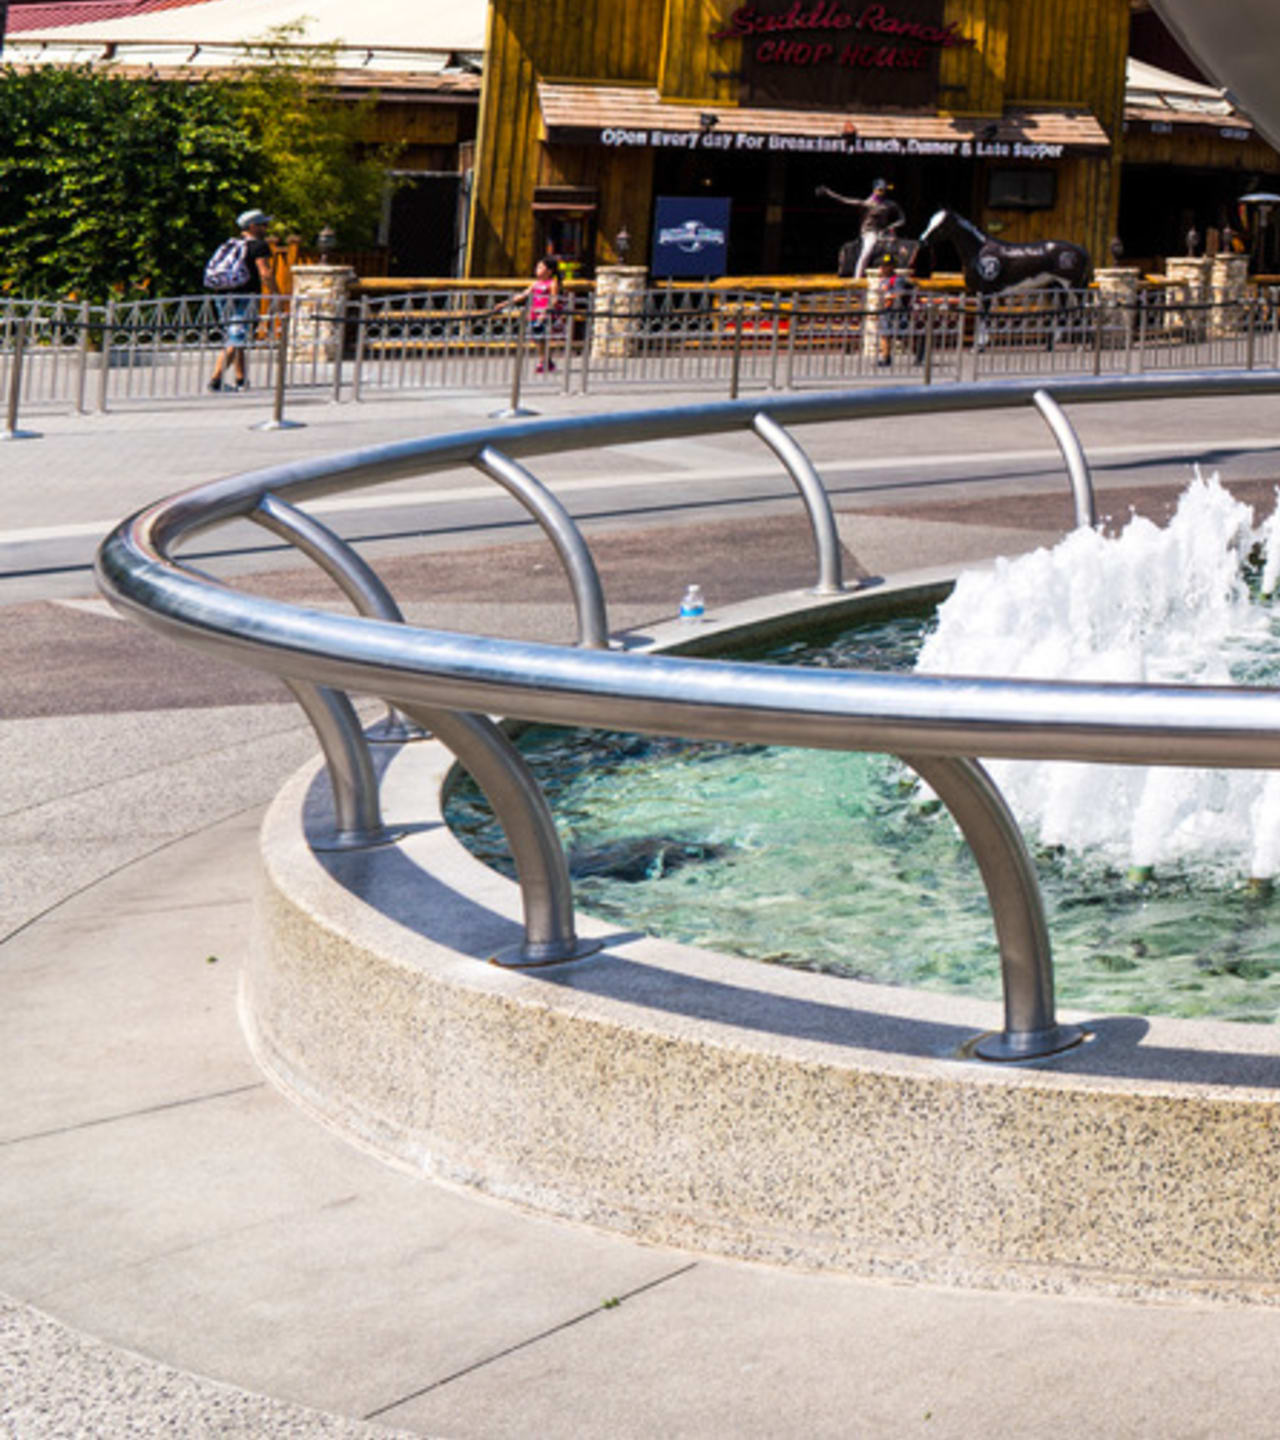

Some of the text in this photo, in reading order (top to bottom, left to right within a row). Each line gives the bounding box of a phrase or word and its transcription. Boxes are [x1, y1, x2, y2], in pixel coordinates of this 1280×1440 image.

[709, 0, 851, 39] Saddle
[757, 39, 924, 67] CHOP HOUSE
[601, 129, 648, 146] Open
[736, 133, 765, 149] For
